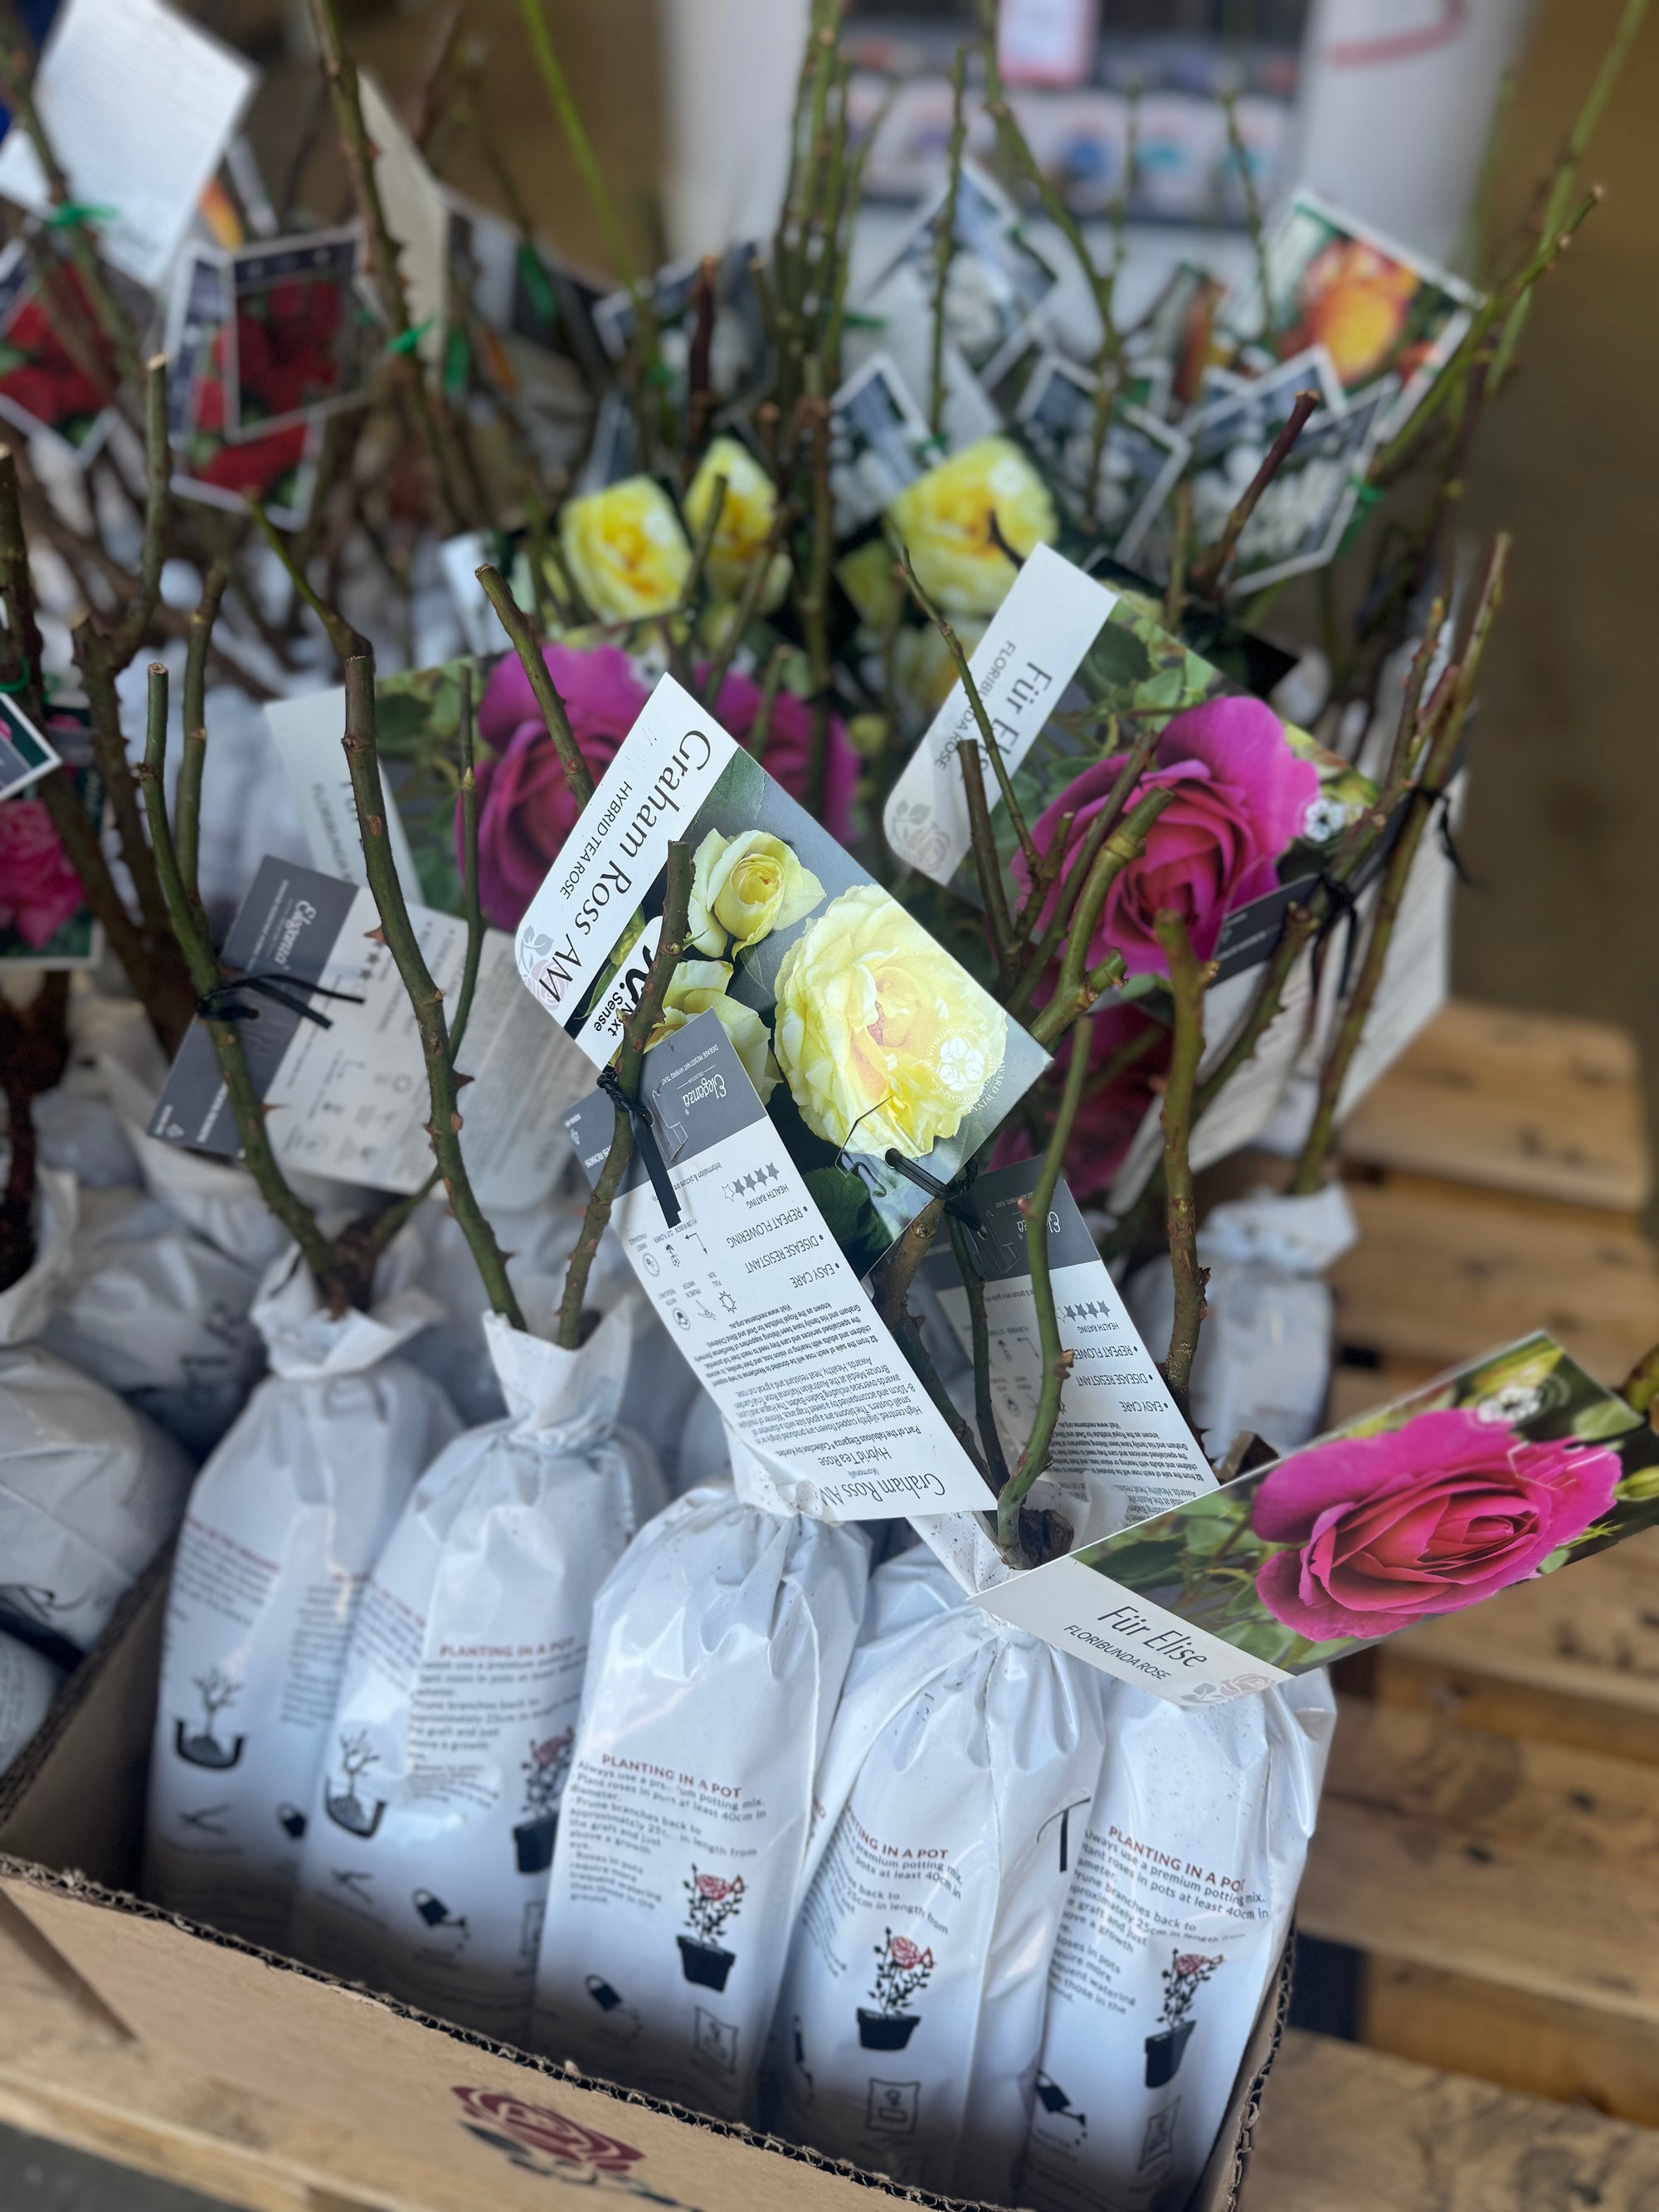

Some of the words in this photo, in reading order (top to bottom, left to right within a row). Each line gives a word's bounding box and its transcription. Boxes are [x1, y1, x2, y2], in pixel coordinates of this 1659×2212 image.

[1006, 662, 1052, 715] Für
[619, 731, 710, 858] Graham
[597, 781, 632, 836] HYBRID
[581, 837, 601, 862] TEA
[560, 861, 586, 899] ROSE
[576, 860, 632, 935] Ross
[539, 933, 581, 1003] AM
[594, 992, 623, 1032] Sense
[607, 1002, 634, 1037] Nxt
[682, 1074, 726, 1106] Eleganza
[766, 1184, 789, 1198] HEALTH
[746, 1194, 766, 1208] RATING
[771, 1207, 803, 1228] REPEAT
[726, 1221, 772, 1247] FLOWERING
[783, 1235, 819, 1257] DISEASE
[745, 1249, 786, 1273] RESISTANT
[812, 1263, 834, 1280] EASY
[789, 1271, 813, 1287] CARE
[779, 1304, 792, 1312] Visit
[838, 1304, 861, 1315] Graham
[828, 1310, 839, 1320] and
[849, 1325, 871, 1335] children
[1077, 1325, 1097, 1333] RATING
[1097, 1322, 1119, 1331] HEALTH
[838, 1331, 849, 1340] and
[868, 1334, 878, 1343] $2
[815, 1349, 829, 1357] each
[1070, 1348, 1103, 1359] FLOWER
[1102, 1345, 1133, 1357] REPEAT
[845, 1357, 872, 1369] Awards.
[807, 1370, 824, 1379] heat
[864, 1364, 890, 1375] Bronze
[784, 1373, 809, 1386] resistant
[828, 1377, 840, 1385] the
[838, 1375, 846, 1383] at
[845, 1370, 867, 1383] Medal
[876, 1373, 900, 1386] awards
[1075, 1374, 1115, 1386] RESISTANT
[1113, 1373, 1148, 1384] DISEASE
[773, 1379, 785, 1389] and
[799, 1379, 830, 1392] Australian
[849, 1379, 877, 1391] overseas
[888, 1383, 915, 1393] 8-10cm
[776, 1387, 802, 1399] National
[822, 1386, 852, 1398] including
[876, 1388, 889, 1398] and
[837, 1391, 877, 1407] accompanied
[866, 1399, 893, 1410] clusters.
[893, 1395, 911, 1407] small
[808, 1403, 826, 1412] sweet
[833, 1407, 857, 1417] blooms
[854, 1405, 869, 1413] The
[903, 1405, 922, 1416] High
[1118, 1401, 1141, 1412] CARE
[1141, 1401, 1163, 1412] EASY
[805, 1414, 820, 1425] good
[856, 1413, 879, 1425] slightly
[877, 1408, 905, 1421] centred,
[814, 1422, 837, 1432] flowers
[834, 1418, 857, 1430] cupped
[903, 1425, 921, 1435] Part
[859, 1432, 887, 1441] fabulous
[885, 1429, 898, 1438] the
[897, 1427, 905, 1437] of
[801, 1442, 830, 1452] Collection
[833, 1437, 861, 1446] Eleganza
[839, 1452, 860, 1464] Tea
[856, 1446, 891, 1462] Hybrid
[817, 1455, 842, 1466] Rose
[841, 1481, 883, 1501] Ross
[877, 1473, 945, 1498] Graham
[820, 1485, 844, 1506] AM
[1097, 1606, 1151, 1636] Für
[1142, 1630, 1207, 1667] Elise
[440, 1646, 513, 1657] PLANTING
[1063, 1624, 1140, 1666] FLORIBUNDA
[1136, 1662, 1171, 1680] ROSE
[602, 1754, 674, 1780] PLANTING
[679, 1773, 694, 1786] IN
[698, 1780, 708, 1790] A
[712, 1783, 742, 1798] POT
[578, 1761, 615, 1780] Always
[700, 1792, 738, 1811] potting
[742, 1797, 765, 1809] mix.
[883, 1845, 899, 1856] IN
[902, 1850, 913, 1858] A
[917, 1850, 949, 1859] POT
[1108, 1826, 1181, 1871] PLANTING
[1185, 1863, 1203, 1879] IN
[1205, 1872, 1216, 1884] A
[902, 1860, 944, 1871] potting
[1121, 1850, 1138, 1864] use
[1141, 1860, 1148, 1869] a
[1150, 1864, 1201, 1892] premium
[1204, 1885, 1244, 1907] potting
[1246, 1892, 1265, 1904] mix.
[1108, 1855, 1134, 1878] roses
[1137, 1874, 1148, 1885] in
[1151, 1878, 1175, 1899] pots
[1180, 1894, 1190, 1903] at
[1194, 1895, 1222, 1913] least
[1226, 1908, 1254, 1919] 40cm
[1258, 1908, 1268, 1918] in
[1154, 1913, 1180, 1928] back
[1185, 1921, 1196, 1931] to
